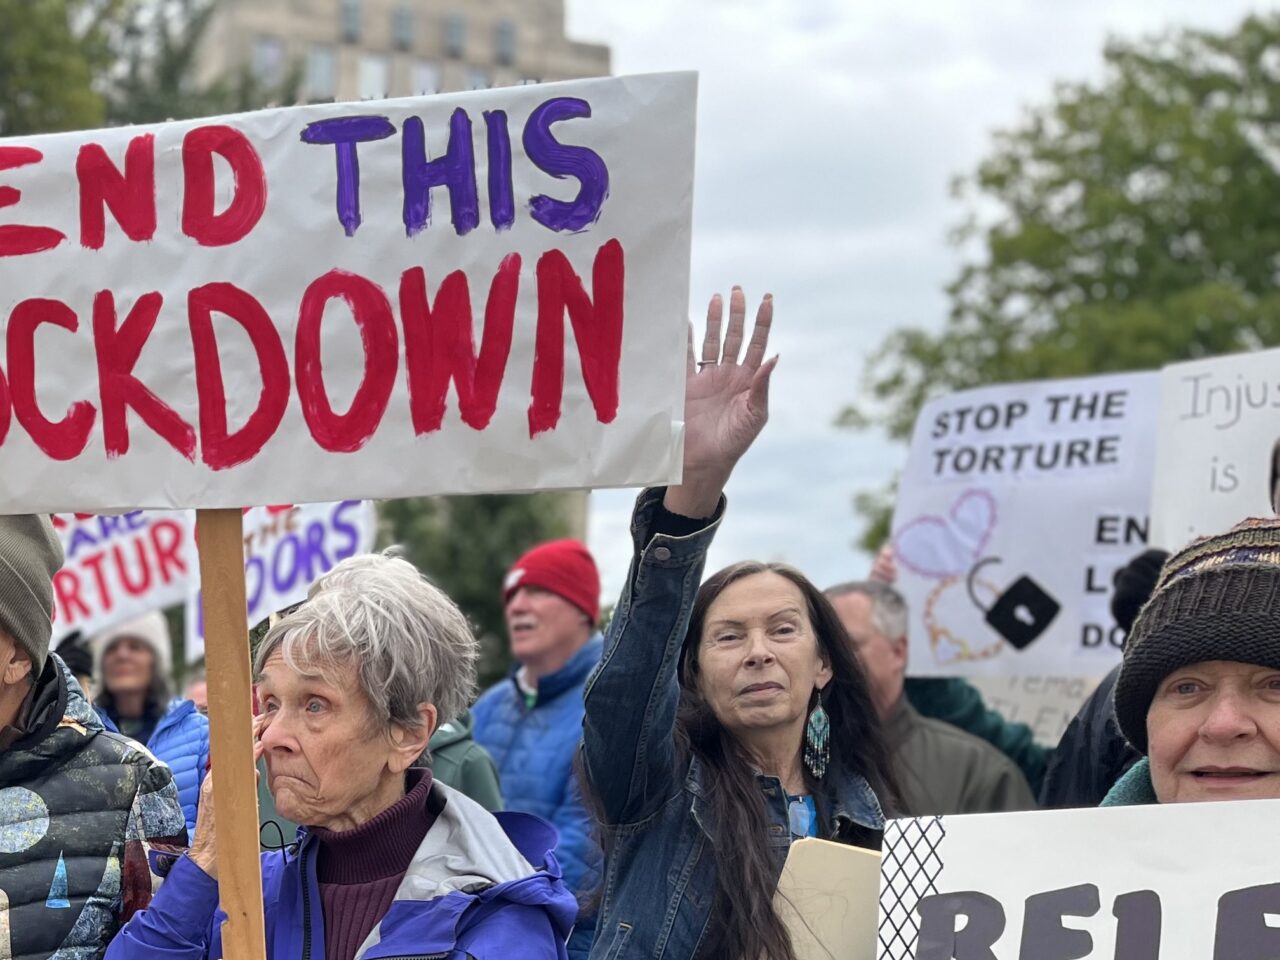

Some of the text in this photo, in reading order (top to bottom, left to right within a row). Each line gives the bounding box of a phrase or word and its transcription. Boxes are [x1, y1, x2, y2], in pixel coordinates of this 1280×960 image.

[300, 96, 610, 238] THIS
[931, 390, 1129, 438] STOP THE
[932, 436, 1121, 476] TORTURE
[1211, 455, 1240, 493] is
[67, 509, 150, 557] ARE
[1095, 515, 1150, 545] EN
[52, 519, 198, 625] RTUR
[1081, 623, 1126, 649] DO
